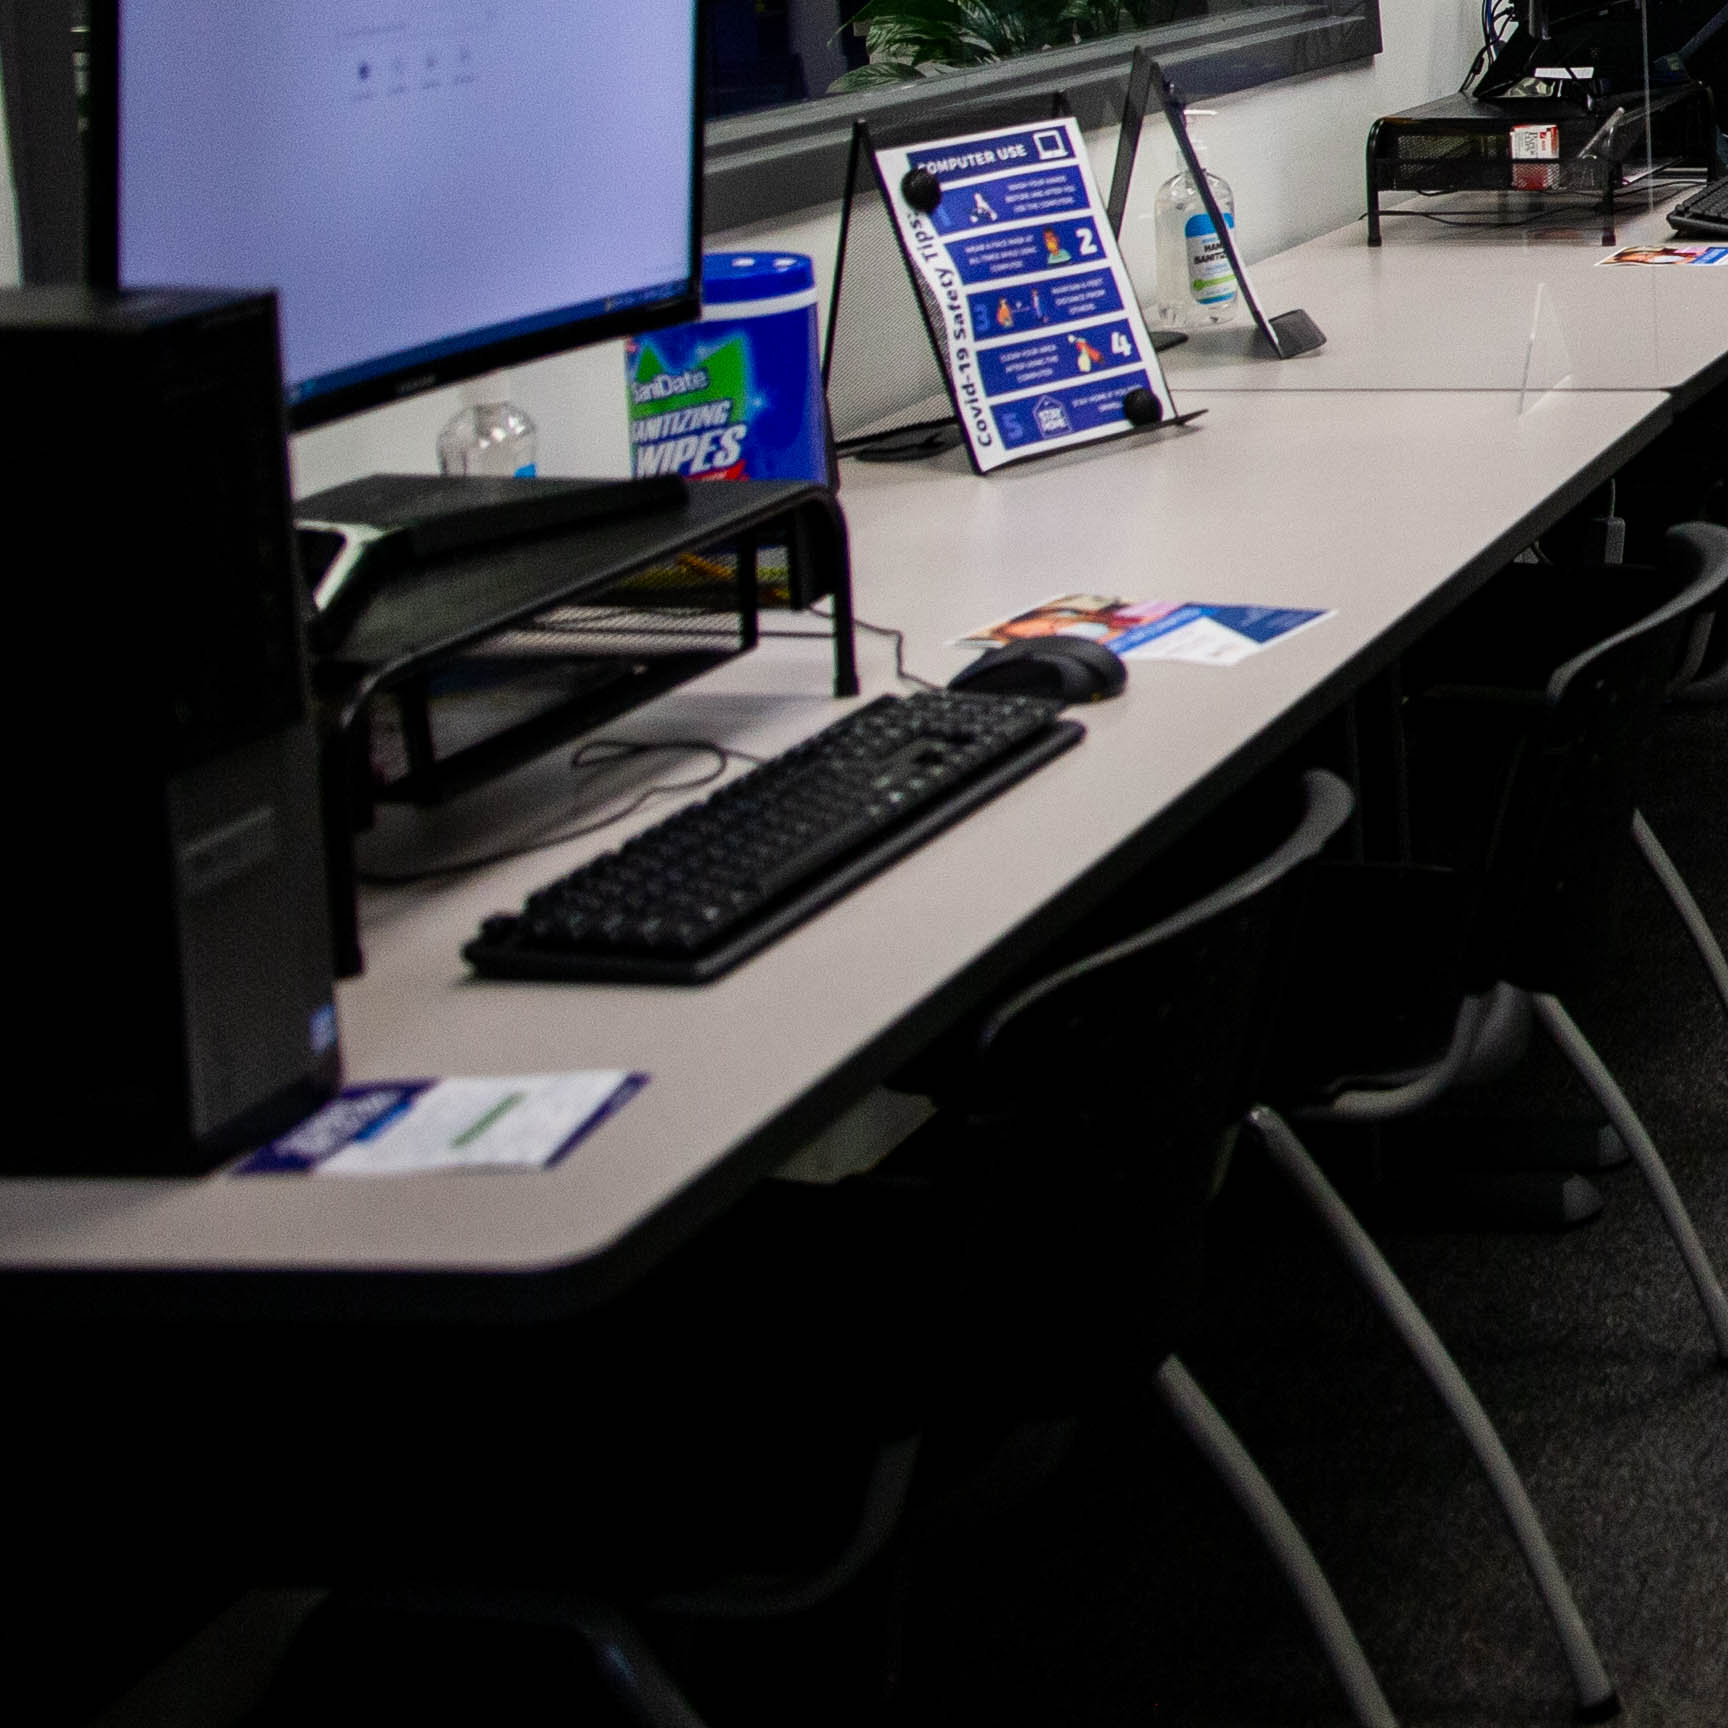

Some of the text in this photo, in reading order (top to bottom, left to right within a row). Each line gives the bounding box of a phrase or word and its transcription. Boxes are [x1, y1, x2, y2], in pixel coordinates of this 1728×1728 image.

[996, 143, 1028, 161] USE
[1076, 227, 1098, 256] 2
[935, 266, 967, 341] Safety
[973, 303, 990, 332] 3
[1111, 331, 1131, 357] 4
[956, 342, 992, 448] Covid-19
[1002, 412, 1023, 440] 5
[636, 422, 748, 478] WIPES
